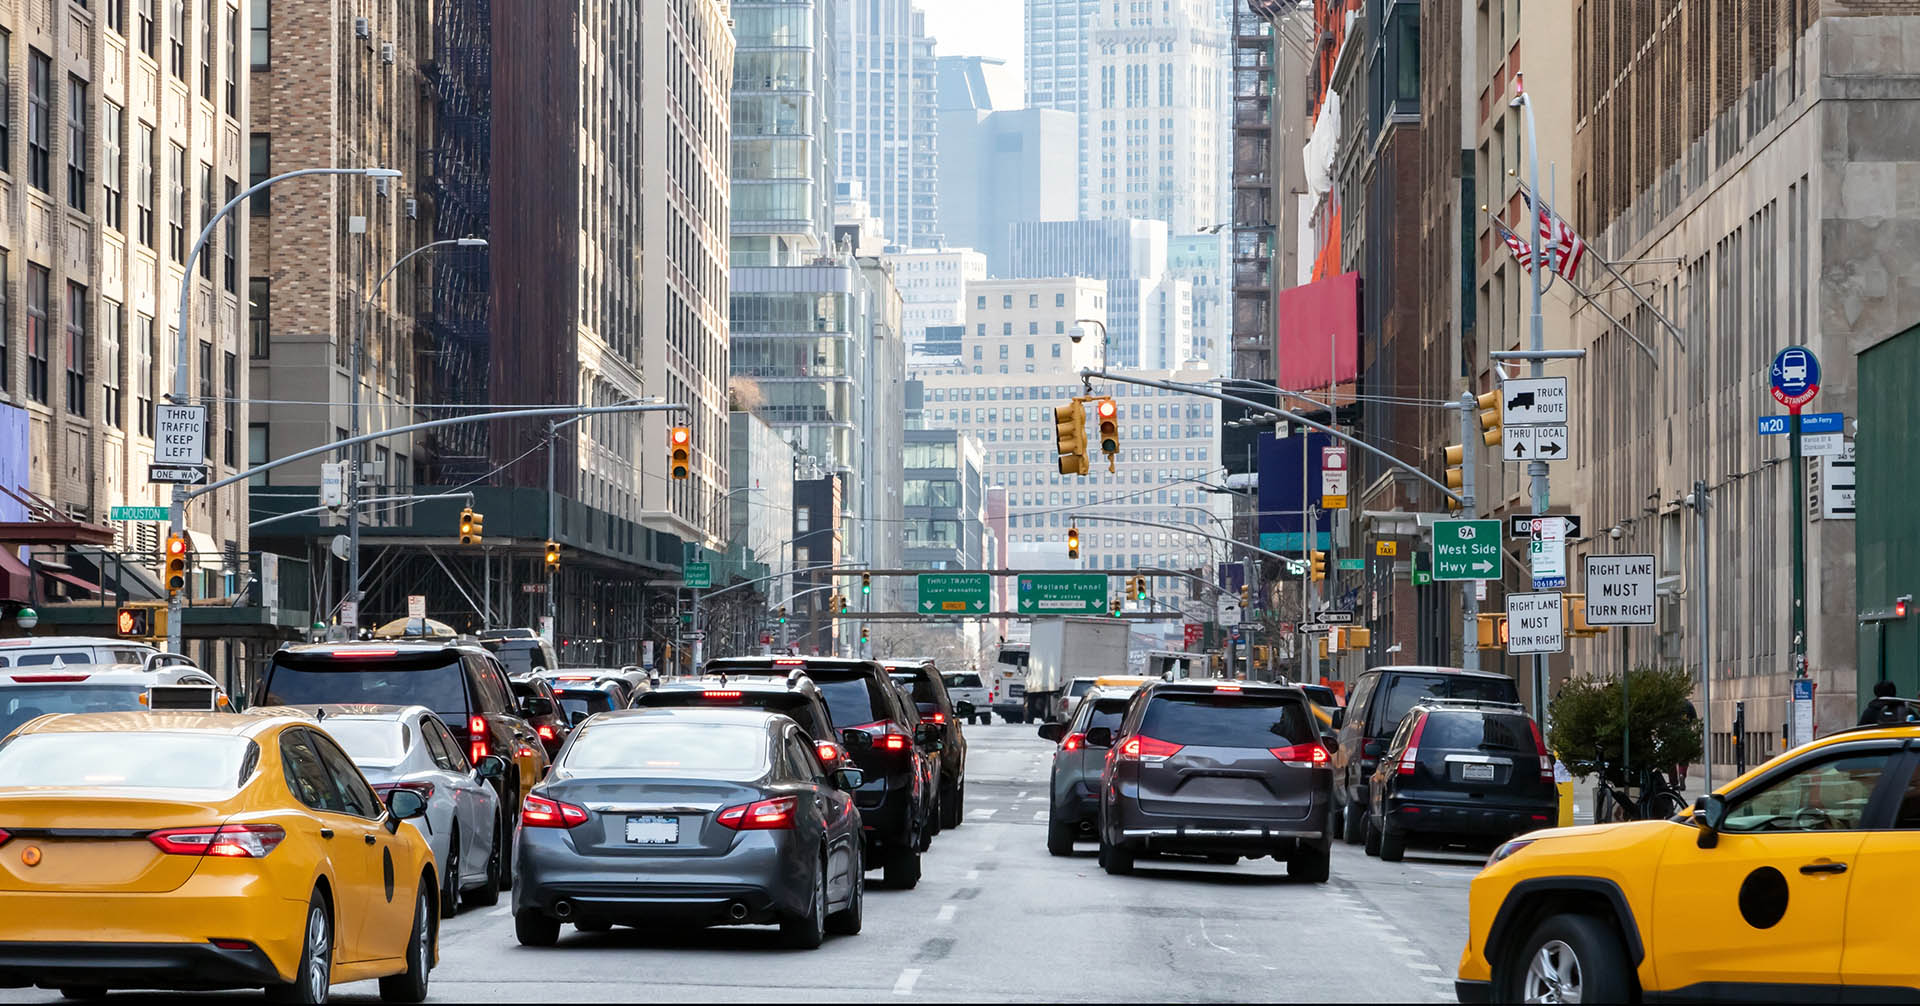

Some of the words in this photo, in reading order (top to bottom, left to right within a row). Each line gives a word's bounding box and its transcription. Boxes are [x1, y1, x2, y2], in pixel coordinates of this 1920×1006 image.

[1537, 388, 1564, 397] TRUCK
[1774, 390, 1784, 400] NO
[1784, 388, 1815, 404] STANDING
[1537, 404, 1564, 413] ROUTE
[167, 409, 196, 420] THRU
[161, 421, 200, 433] TRAFFIC
[1760, 418, 1784, 433] M20
[1509, 430, 1530, 438] THRU
[1538, 428, 1564, 438] LOCAL
[165, 434, 194, 445] KEEP
[165, 448, 193, 457] LEFT
[156, 470, 174, 479] ONE
[181, 472, 199, 480] WAY
[112, 508, 120, 518] W
[122, 508, 160, 519] HOUSTON
[1460, 528, 1474, 538] 9A
[1438, 544, 1467, 554] West
[1471, 544, 1496, 554] Side
[1534, 543, 1540, 552] 2
[1440, 562, 1466, 574] Hwy
[1590, 564, 1620, 576] RIGHT
[1625, 564, 1652, 574] LANE
[1417, 573, 1430, 582] TD
[1603, 584, 1638, 596] MUST
[1510, 601, 1534, 611] RIGHT
[1538, 600, 1558, 610] LANE
[1590, 606, 1617, 616] TURN
[1622, 604, 1652, 616] RIGHT
[1520, 616, 1548, 629] MUST
[1511, 636, 1532, 646] TURN
[1536, 634, 1560, 645] RIGHT
